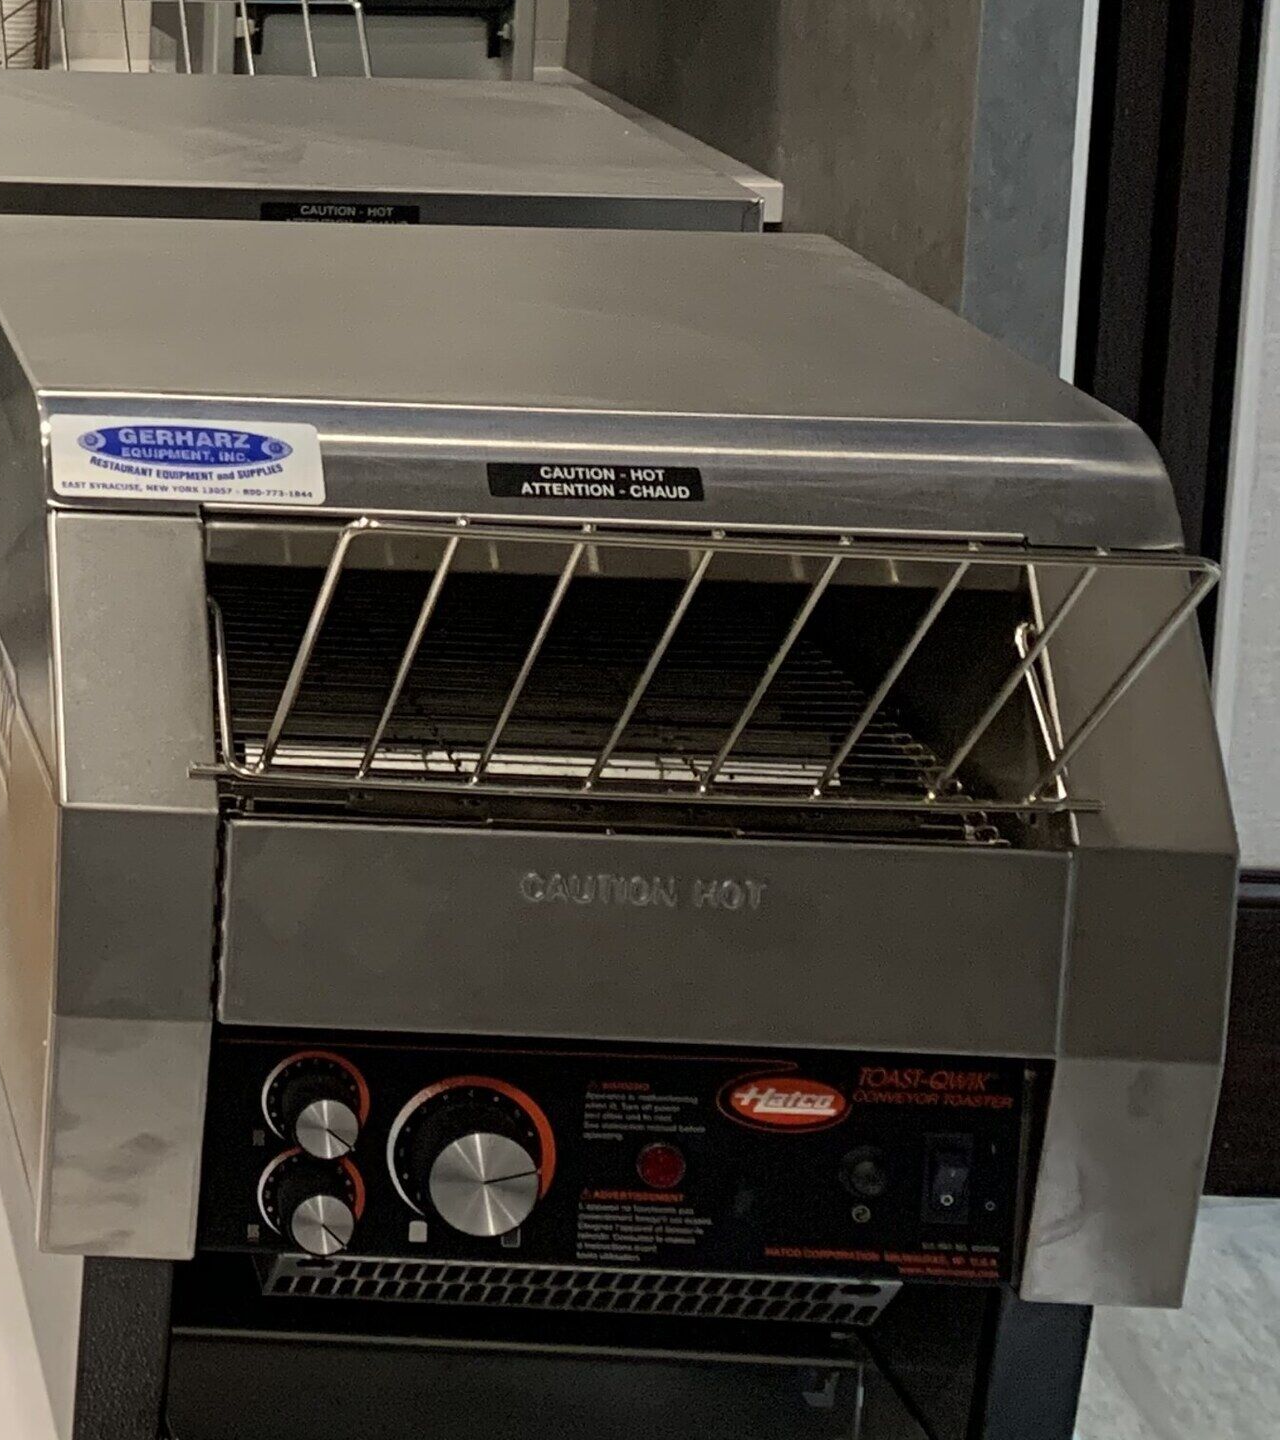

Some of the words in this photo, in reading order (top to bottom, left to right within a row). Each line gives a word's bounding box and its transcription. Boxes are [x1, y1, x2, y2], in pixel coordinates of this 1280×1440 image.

[300, 205, 356, 217] CAUTION
[367, 206, 395, 217] HOT
[118, 428, 251, 448] GERHARZ
[121, 446, 214, 461] EQUIPMENT,
[218, 450, 250, 462] INC.
[90, 456, 153, 477] RESTAURANT
[156, 466, 213, 481] EQUIPMENT
[217, 470, 235, 480] and
[237, 463, 284, 480] SUPPLIES
[540, 466, 615, 481] CAUTION
[631, 469, 665, 482] HOT
[62, 480, 86, 489] EAST
[89, 481, 143, 492] SYRACUSE,
[146, 484, 169, 492] NEW
[172, 484, 199, 493] YORK
[521, 482, 615, 497] ATTENTION
[630, 484, 690, 499] CHAUD
[520, 872, 678, 907] CAUTION
[694, 879, 766, 909] HOT
[734, 1085, 837, 1114] Hatco
[853, 1090, 939, 1105] CONVEYOR
[944, 1093, 1014, 1108] TOASTER
